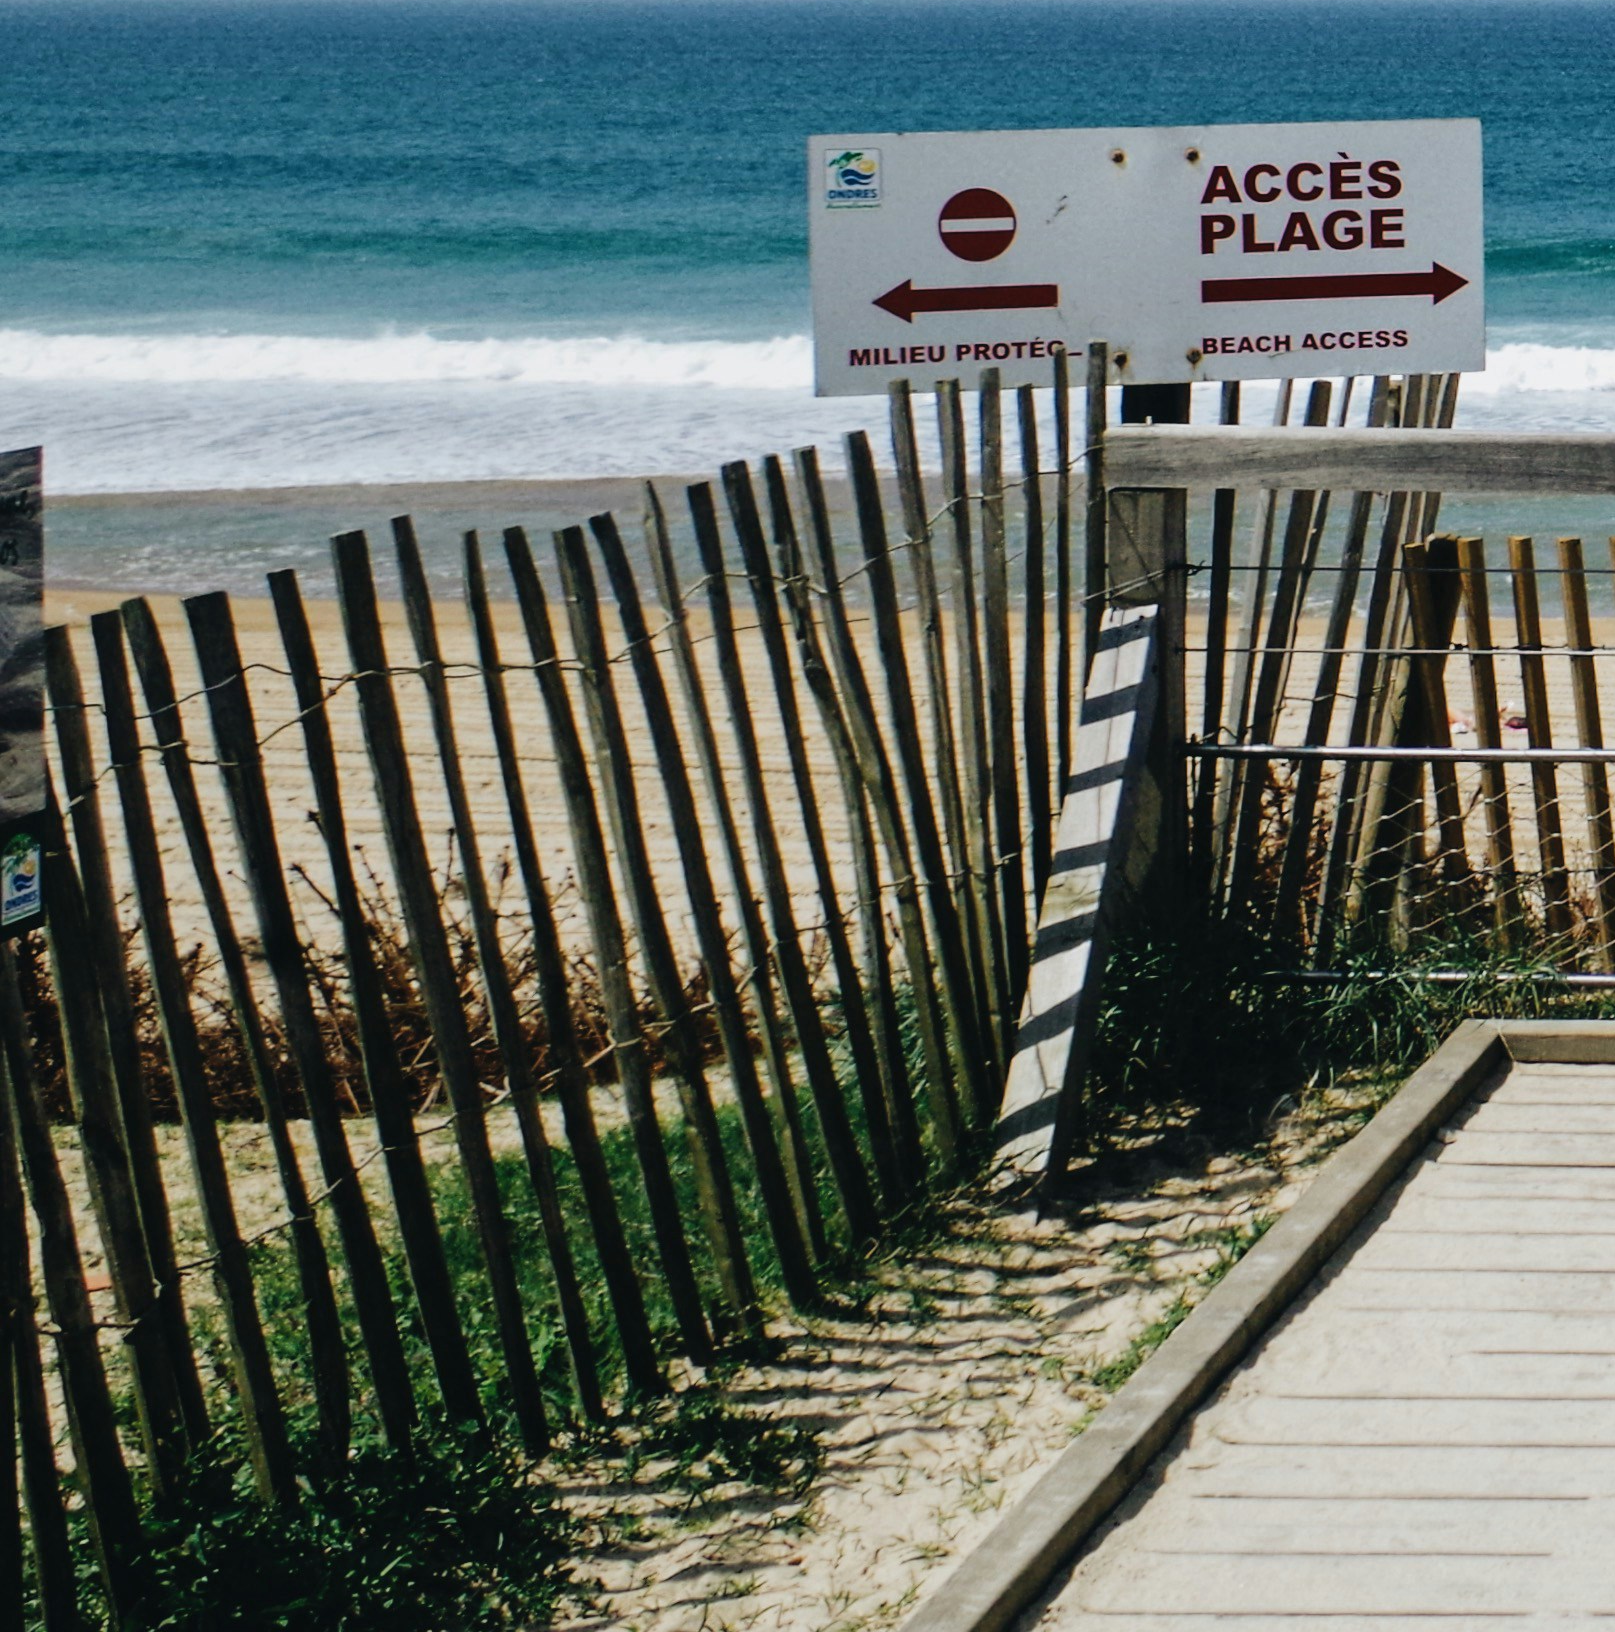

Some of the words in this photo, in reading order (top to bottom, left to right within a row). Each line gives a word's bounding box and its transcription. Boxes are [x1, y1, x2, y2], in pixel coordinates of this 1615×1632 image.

[1201, 151, 1402, 204] ACCÈS
[1201, 208, 1405, 255] PLAGE
[849, 344, 946, 366] MILIEU
[956, 336, 1083, 362] PROTÉ
[1202, 334, 1292, 354] BEACH
[1301, 329, 1409, 350] ACCESS
